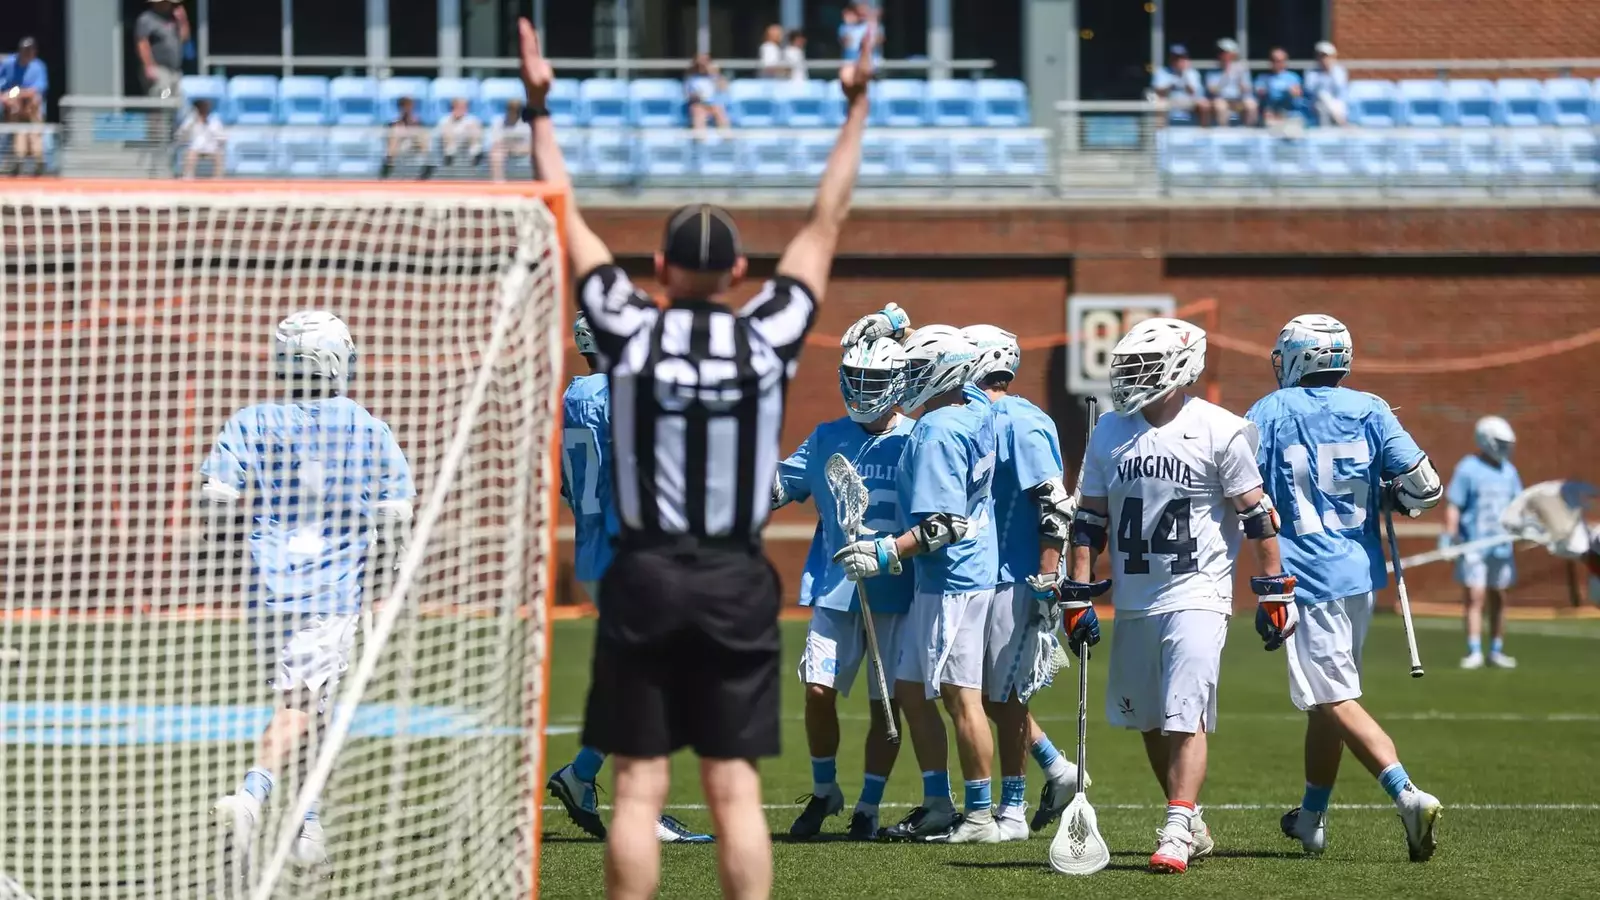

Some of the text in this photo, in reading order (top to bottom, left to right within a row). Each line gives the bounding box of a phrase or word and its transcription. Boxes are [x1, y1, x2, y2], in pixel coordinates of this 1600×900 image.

[1117, 455, 1192, 488] VIRGINIA
[1283, 440, 1370, 537] 15
[1117, 496, 1199, 575] 44
